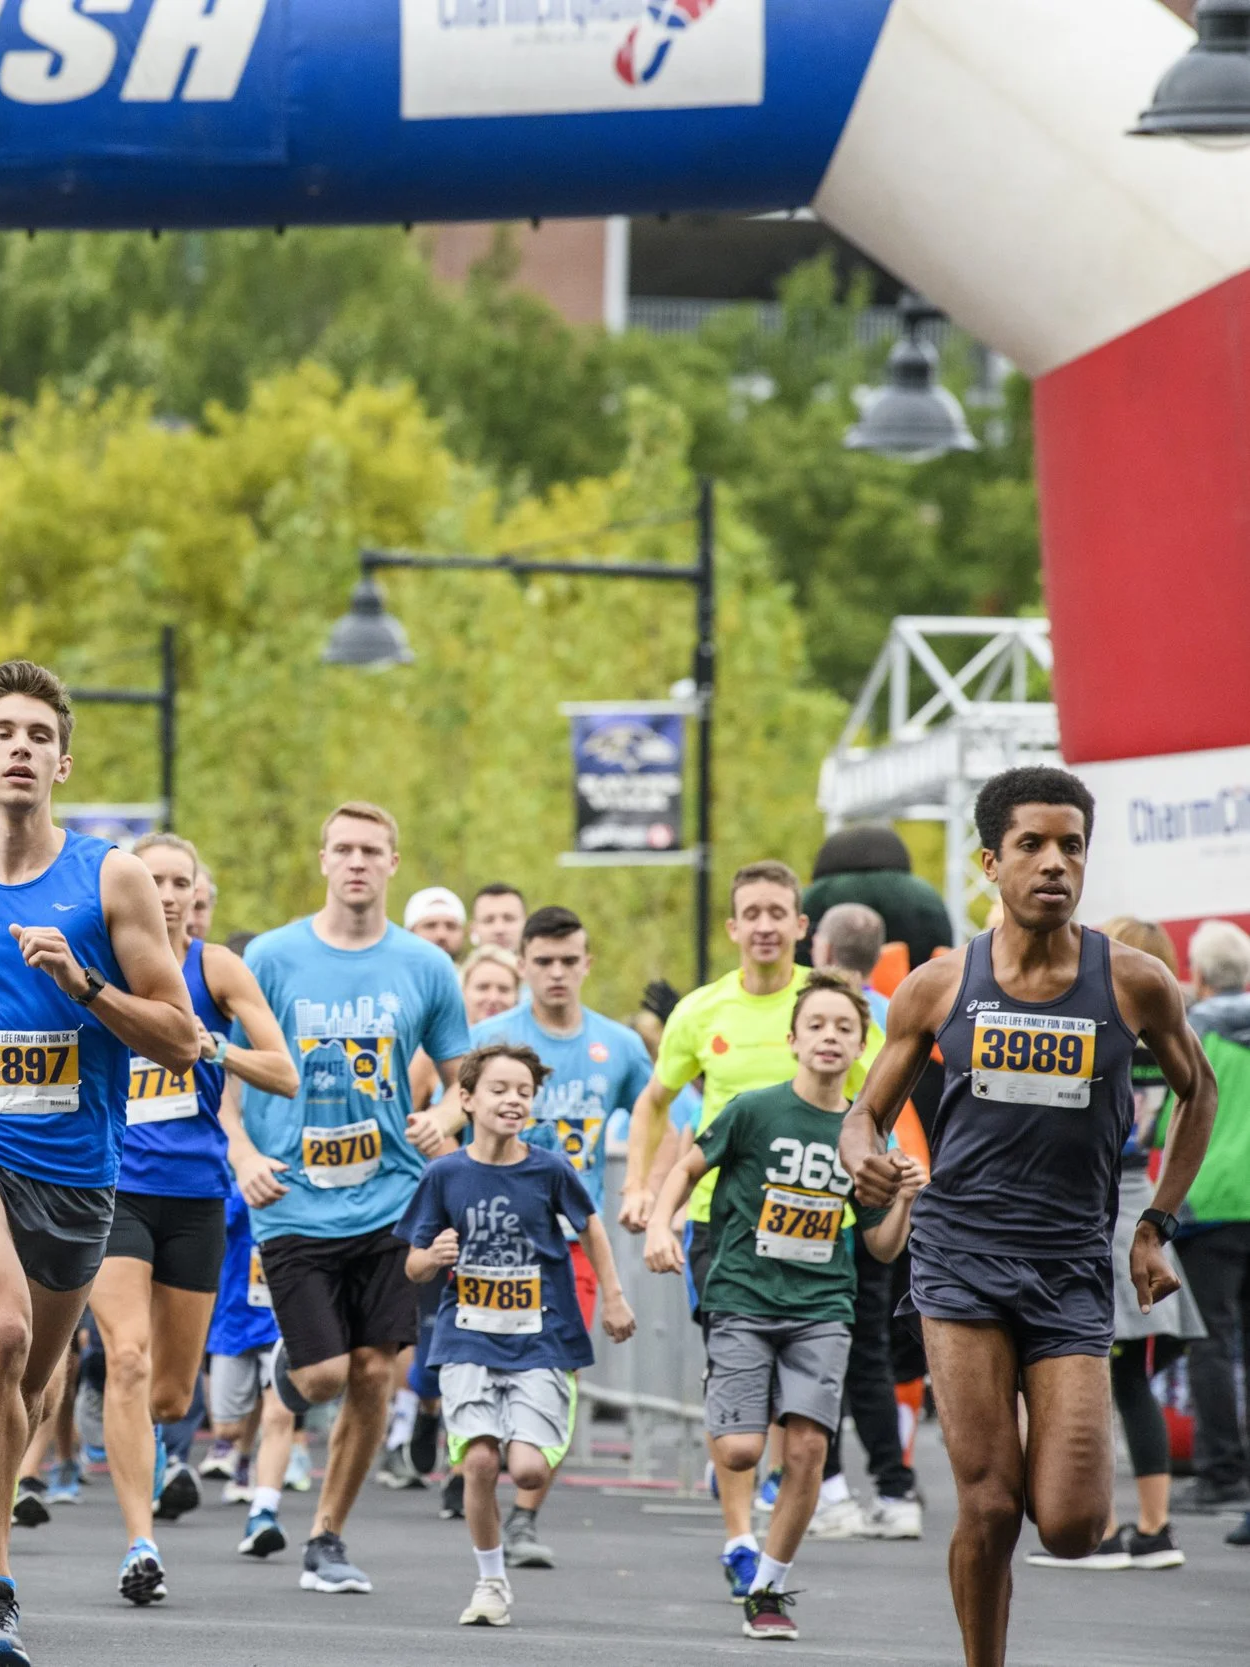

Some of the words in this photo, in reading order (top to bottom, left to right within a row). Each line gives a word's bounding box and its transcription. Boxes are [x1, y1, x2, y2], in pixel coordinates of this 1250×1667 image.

[977, 1001, 1000, 1010] asics
[1, 1034, 13, 1043] LIFE
[14, 1034, 34, 1043] FAMILY
[35, 1034, 47, 1043] FUN
[48, 1034, 60, 1043] RUN
[1009, 1016, 1022, 1026] LIFE
[1023, 1017, 1046, 1028] FAMILY
[1048, 1019, 1060, 1029] FUN
[1061, 1020, 1075, 1030] RUN
[981, 1029, 1083, 1075] 3989
[129, 1067, 187, 1100] 774
[310, 1133, 376, 1167] 2970
[767, 1203, 834, 1239] 3784
[463, 1278, 533, 1310] 3785
